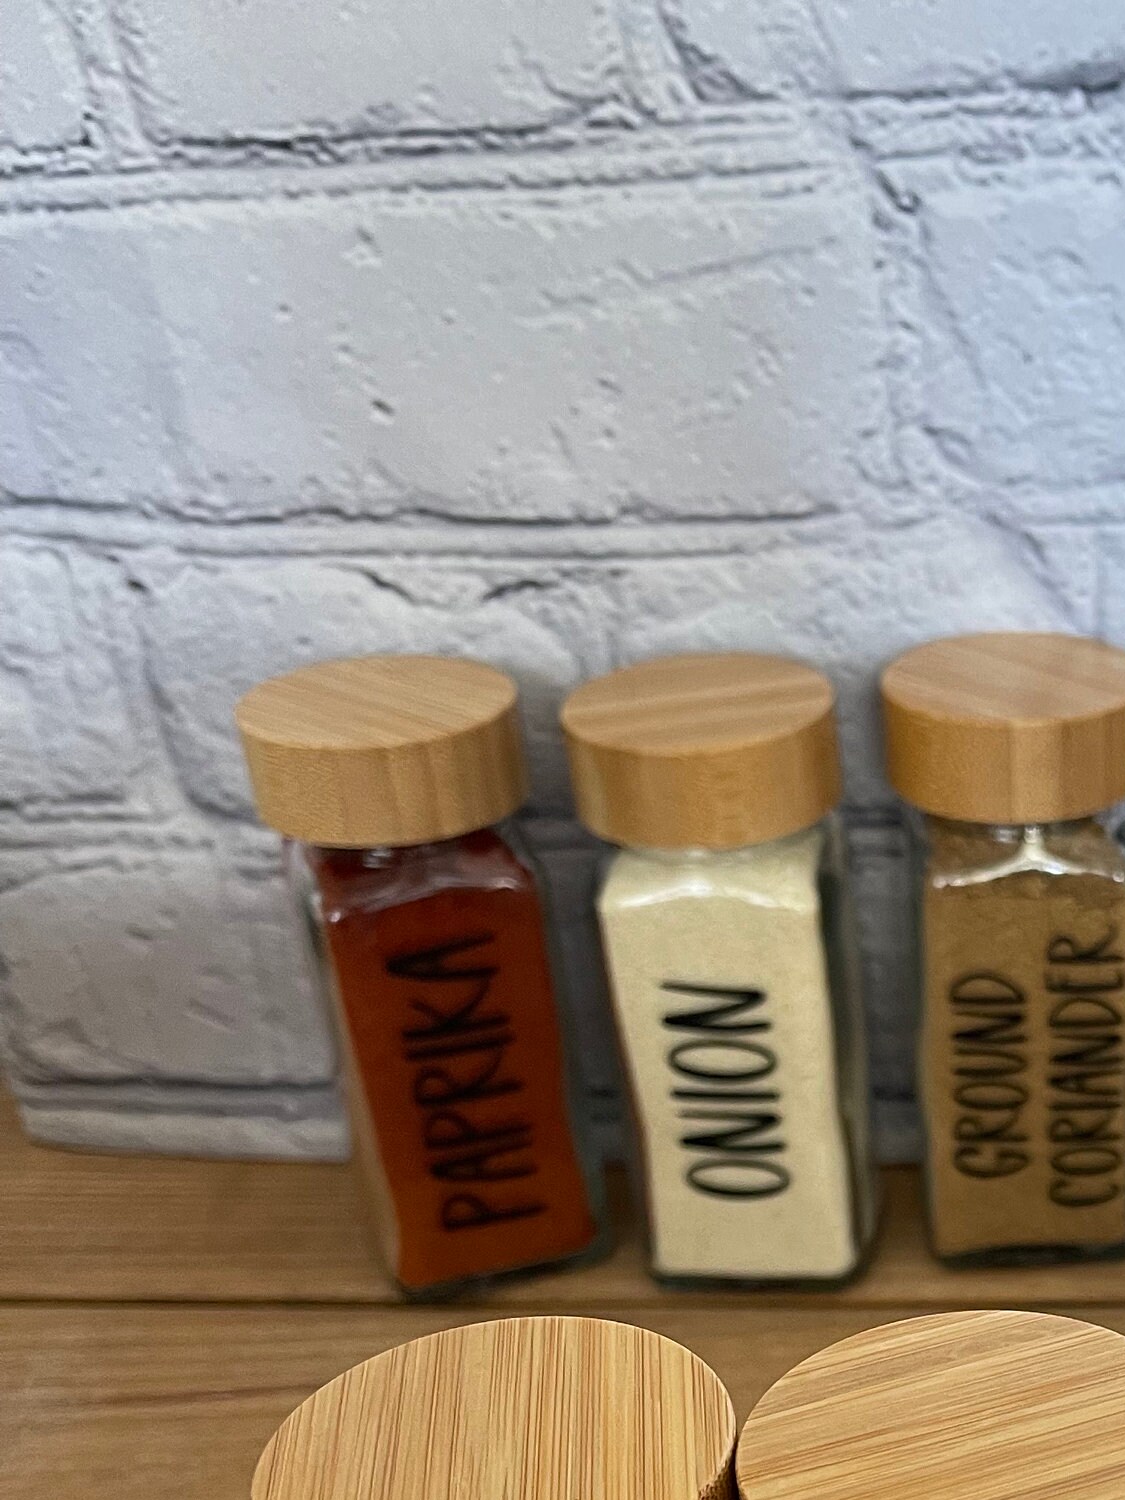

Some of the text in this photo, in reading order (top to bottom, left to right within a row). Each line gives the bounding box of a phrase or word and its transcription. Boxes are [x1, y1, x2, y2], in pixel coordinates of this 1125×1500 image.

[386, 930, 547, 1231] PAPRIKA
[660, 980, 790, 1200] ONION
[949, 968, 1028, 1179] GROUND
[1046, 923, 1125, 1207] CORIANDER
